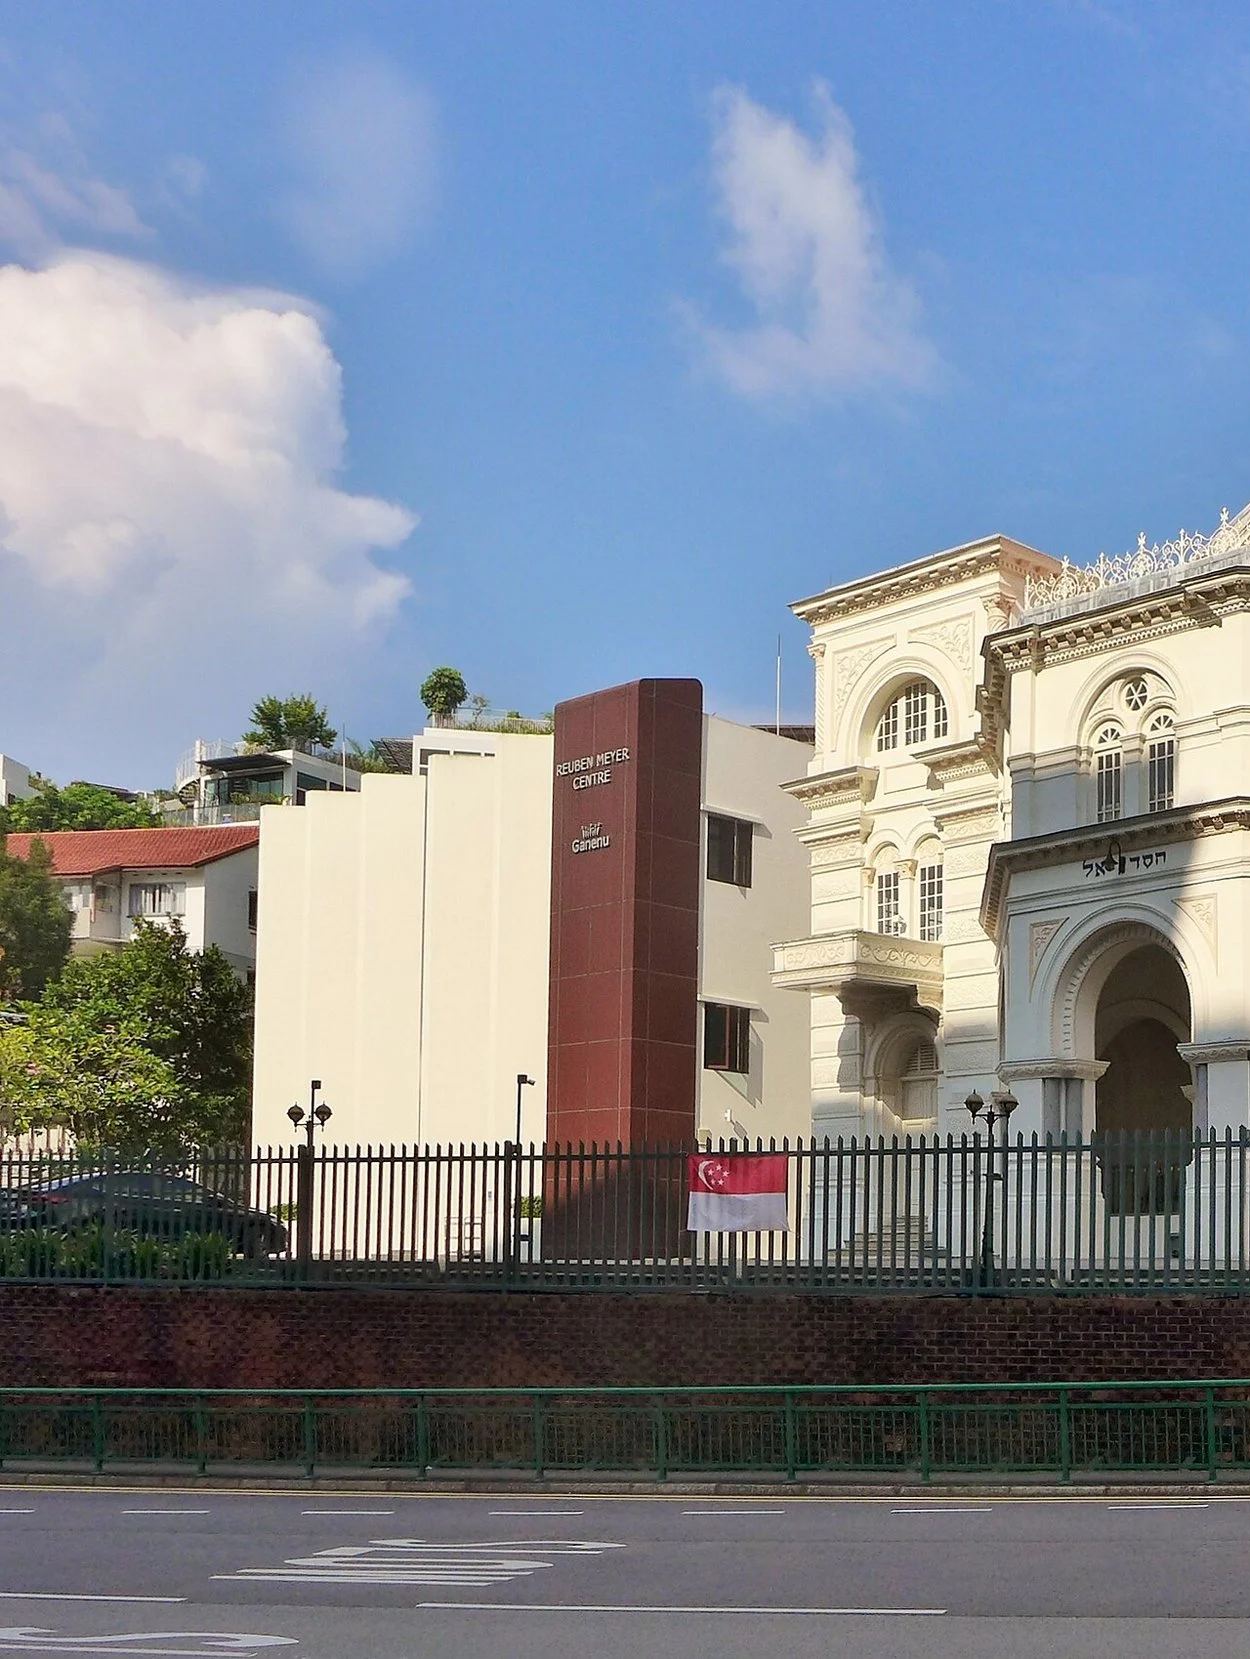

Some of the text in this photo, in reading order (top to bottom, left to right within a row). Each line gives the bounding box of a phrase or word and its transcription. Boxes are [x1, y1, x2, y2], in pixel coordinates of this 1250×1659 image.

[556, 748, 630, 776] REUBEN MEYER
[572, 770, 612, 790] CENTRE
[572, 835, 610, 853] Ganenu
[208, 1539, 628, 1587] SLOW
